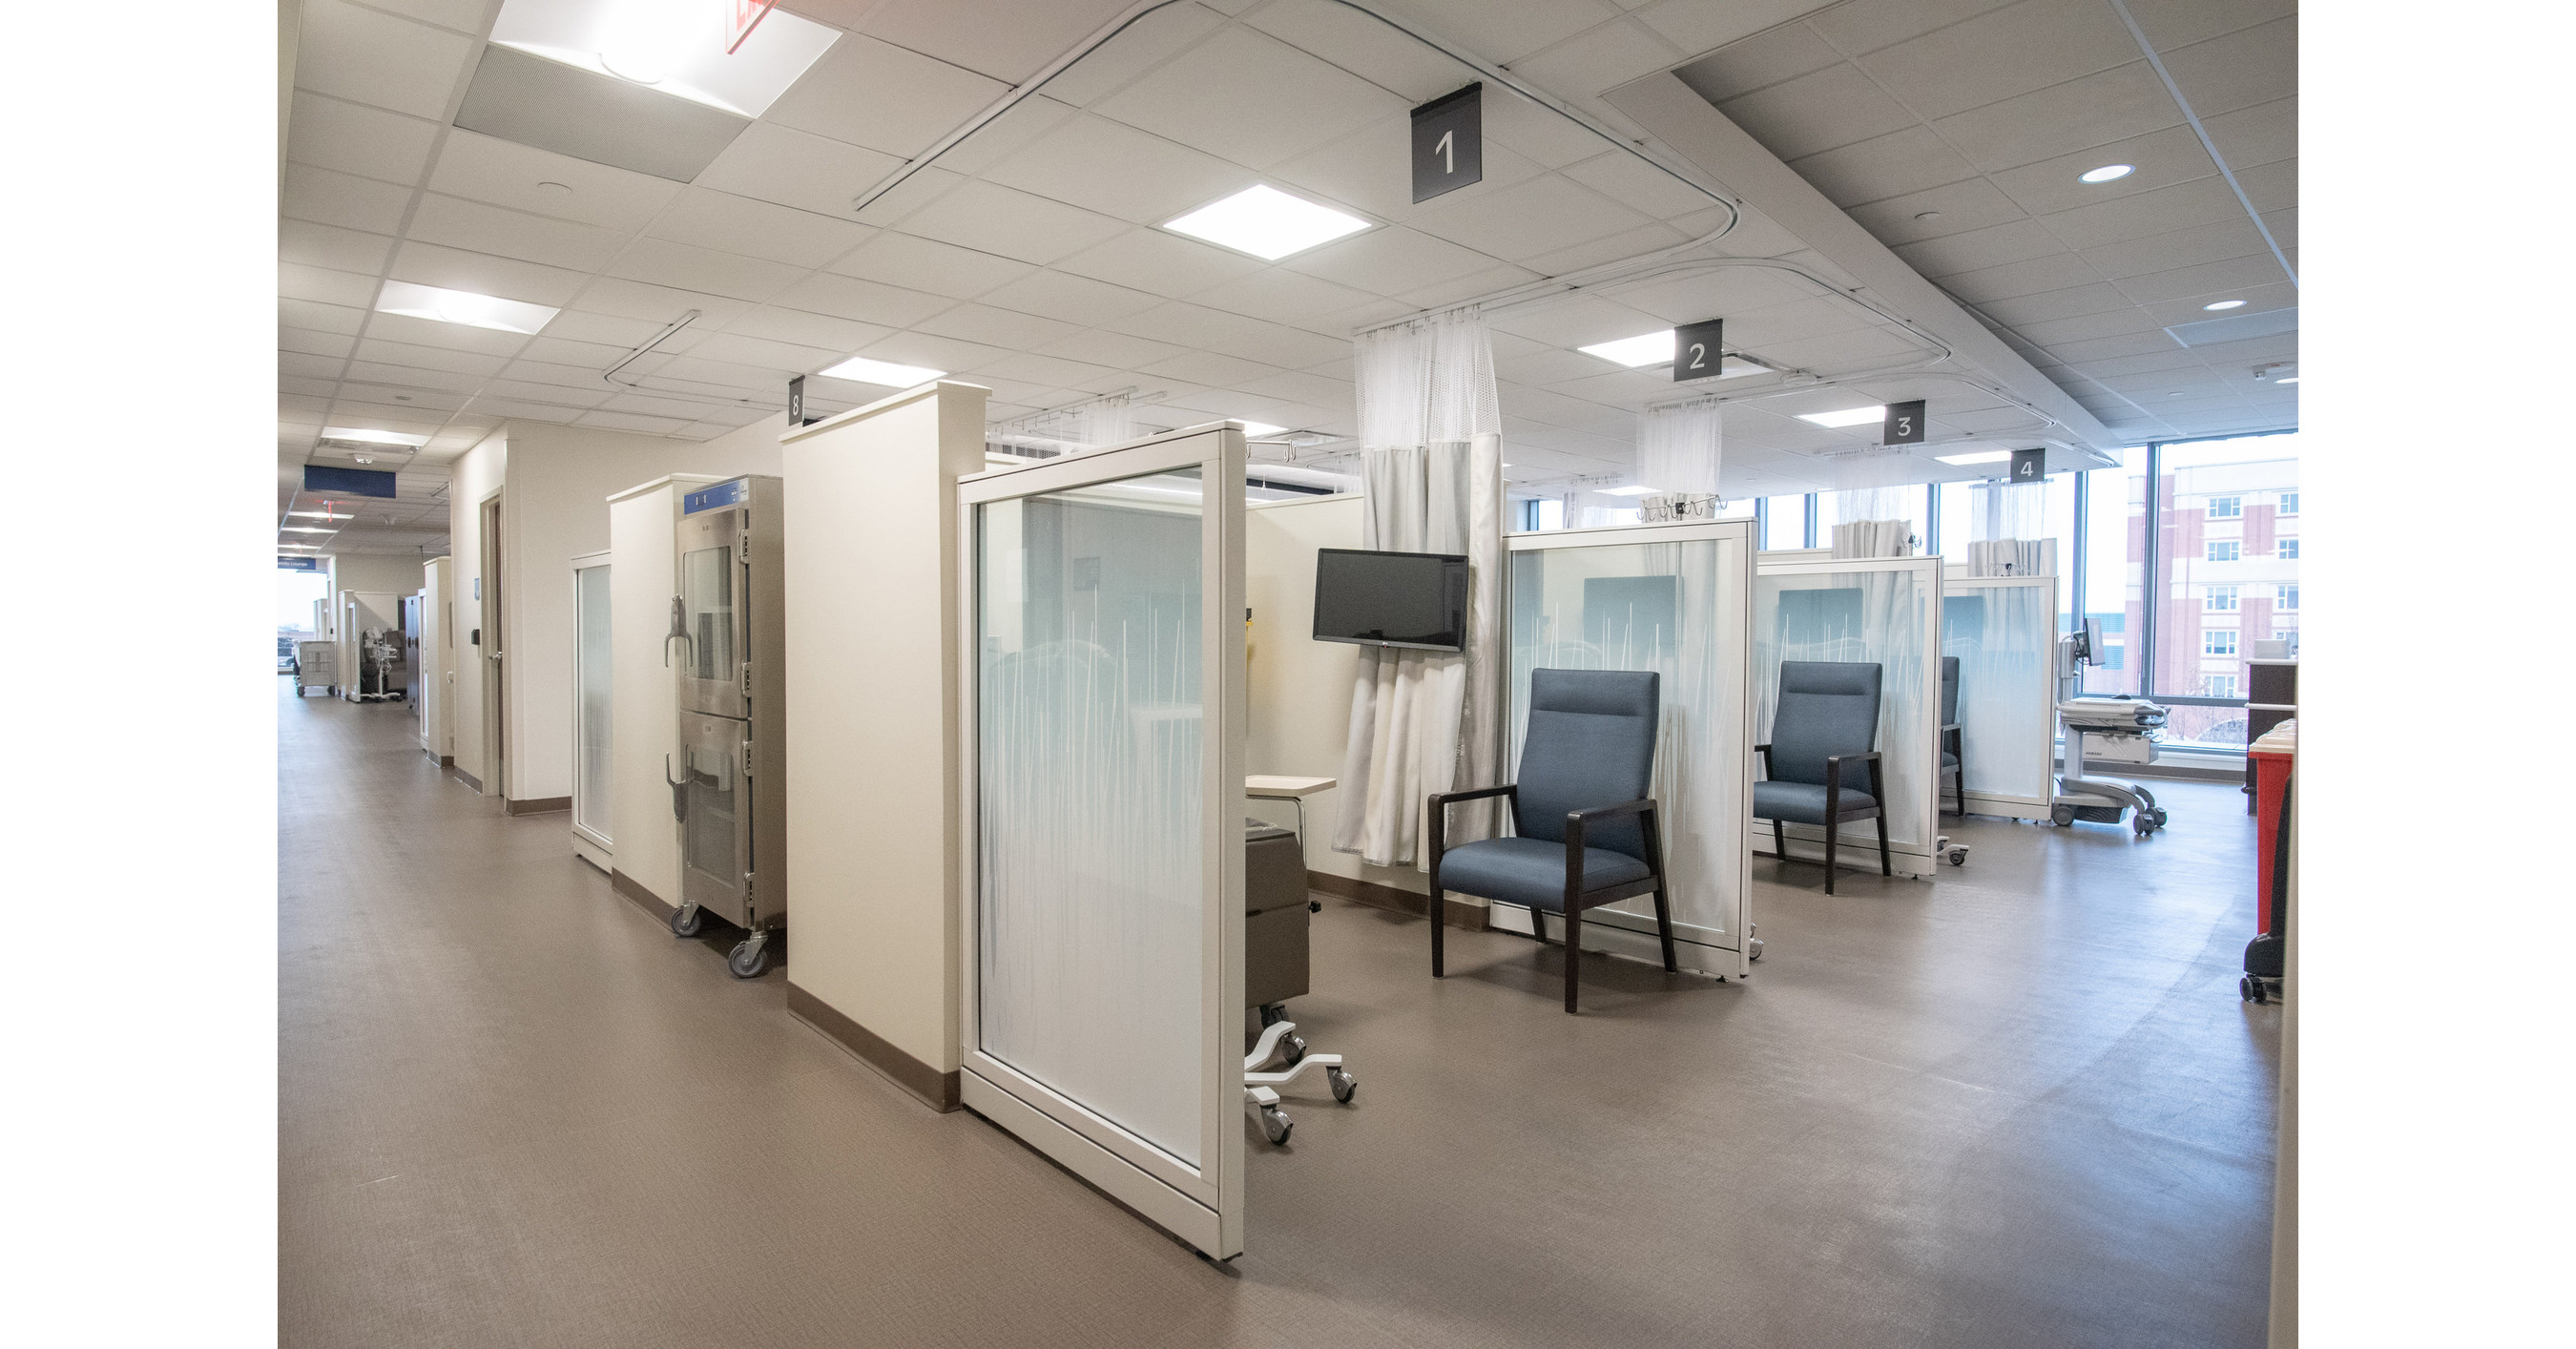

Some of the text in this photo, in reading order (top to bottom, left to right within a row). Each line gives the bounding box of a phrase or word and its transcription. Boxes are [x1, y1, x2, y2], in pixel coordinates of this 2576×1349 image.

[1435, 130, 1454, 175] 1
[1689, 342, 1705, 370] 2
[792, 394, 800, 417] 8
[1898, 417, 1911, 437] 3
[2020, 462, 2034, 477] 4
